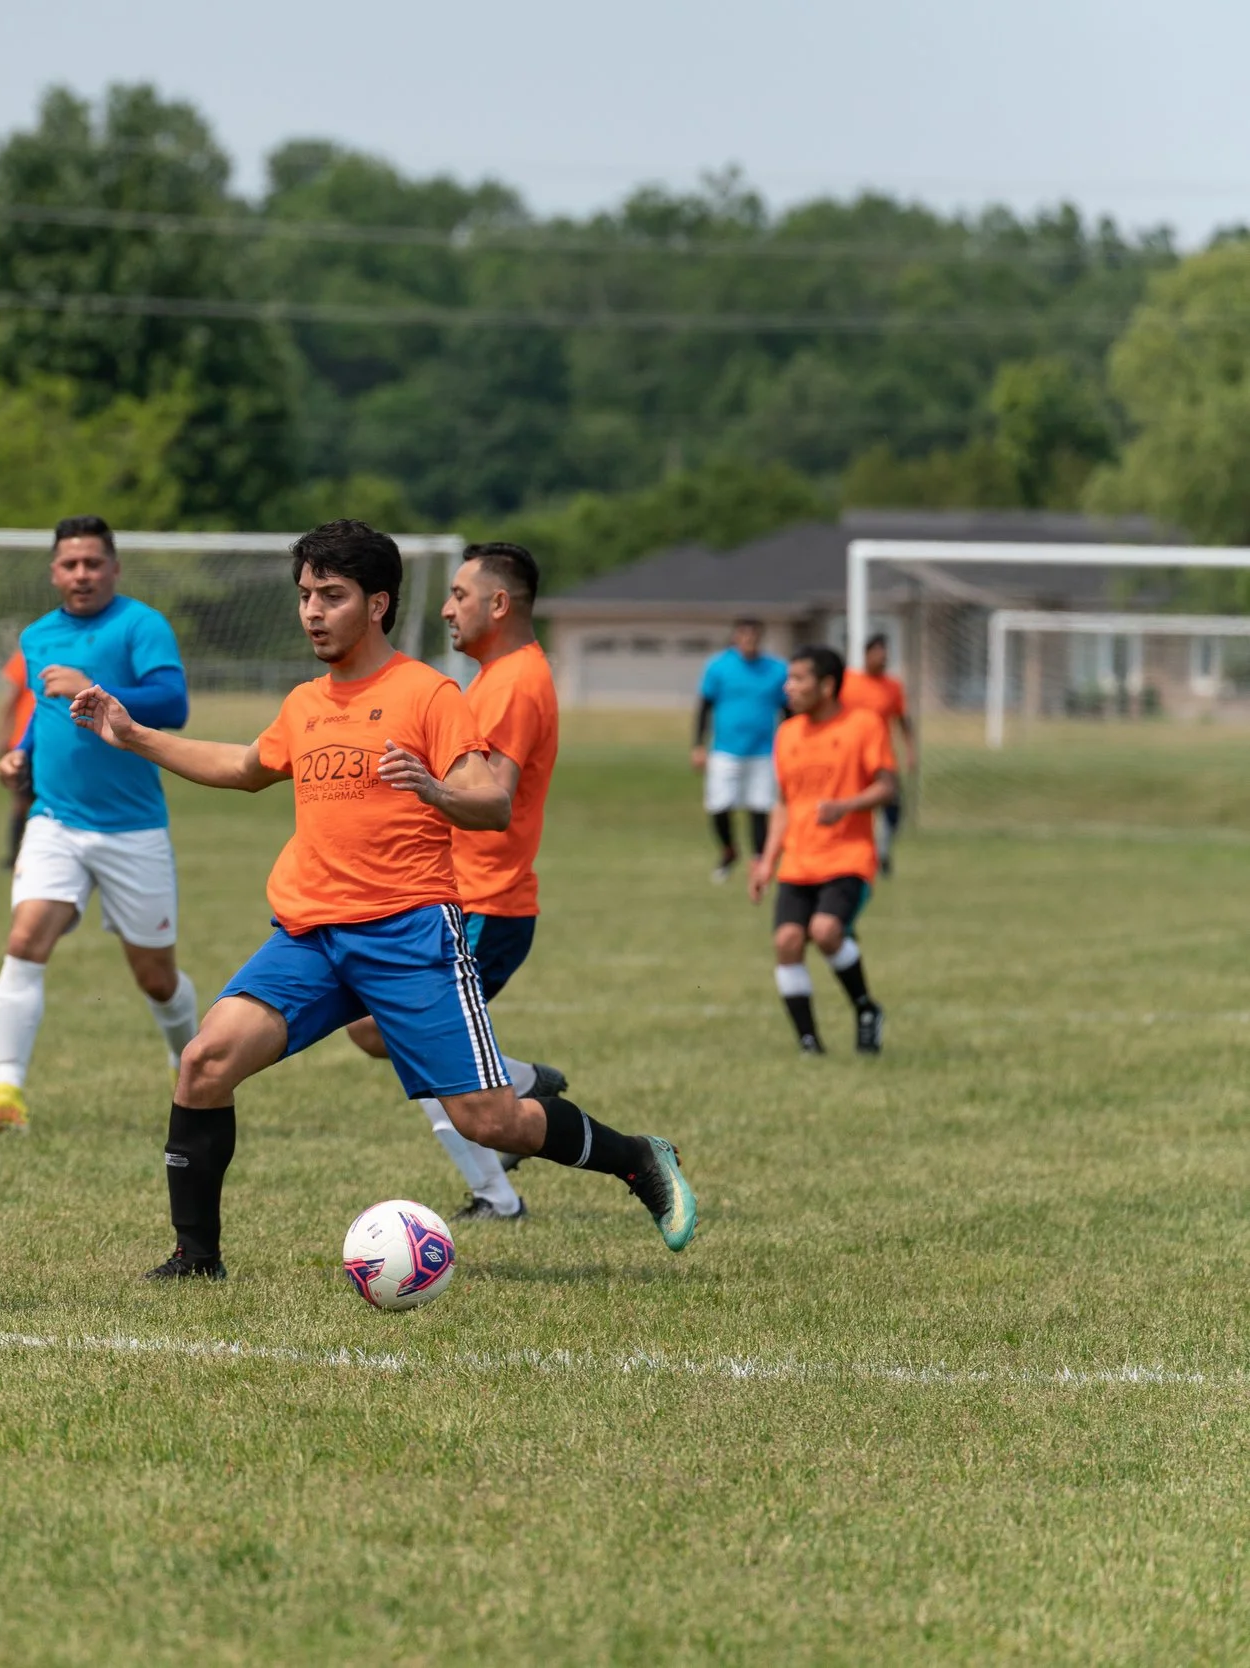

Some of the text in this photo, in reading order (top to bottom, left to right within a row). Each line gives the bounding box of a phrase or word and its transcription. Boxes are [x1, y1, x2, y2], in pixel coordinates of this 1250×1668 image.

[301, 750, 364, 783] 2023
[354, 779, 379, 789] CUP
[322, 790, 365, 801] FARMAS
